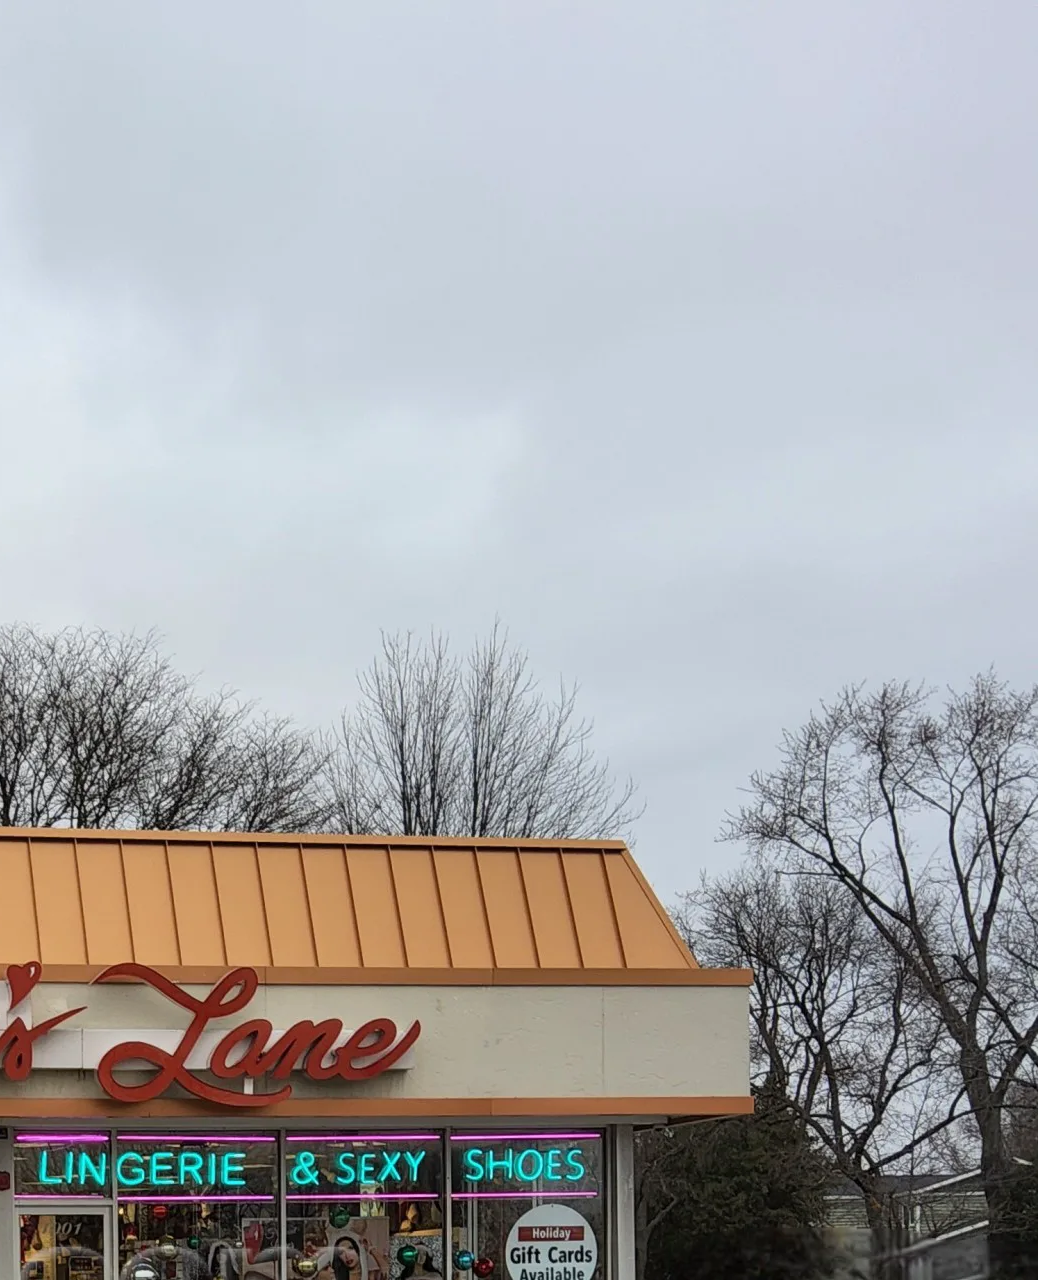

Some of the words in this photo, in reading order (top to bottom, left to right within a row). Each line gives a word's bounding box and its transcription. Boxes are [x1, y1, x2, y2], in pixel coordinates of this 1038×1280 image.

[89, 962, 421, 1107] Lane
[38, 1149, 248, 1187] LINGERIE
[291, 1150, 320, 1186] &
[337, 1150, 427, 1185] SEXY
[464, 1147, 587, 1183] SHOES
[532, 1227, 572, 1241] Holiday
[510, 1245, 541, 1265] Gift
[548, 1244, 593, 1264] Cards
